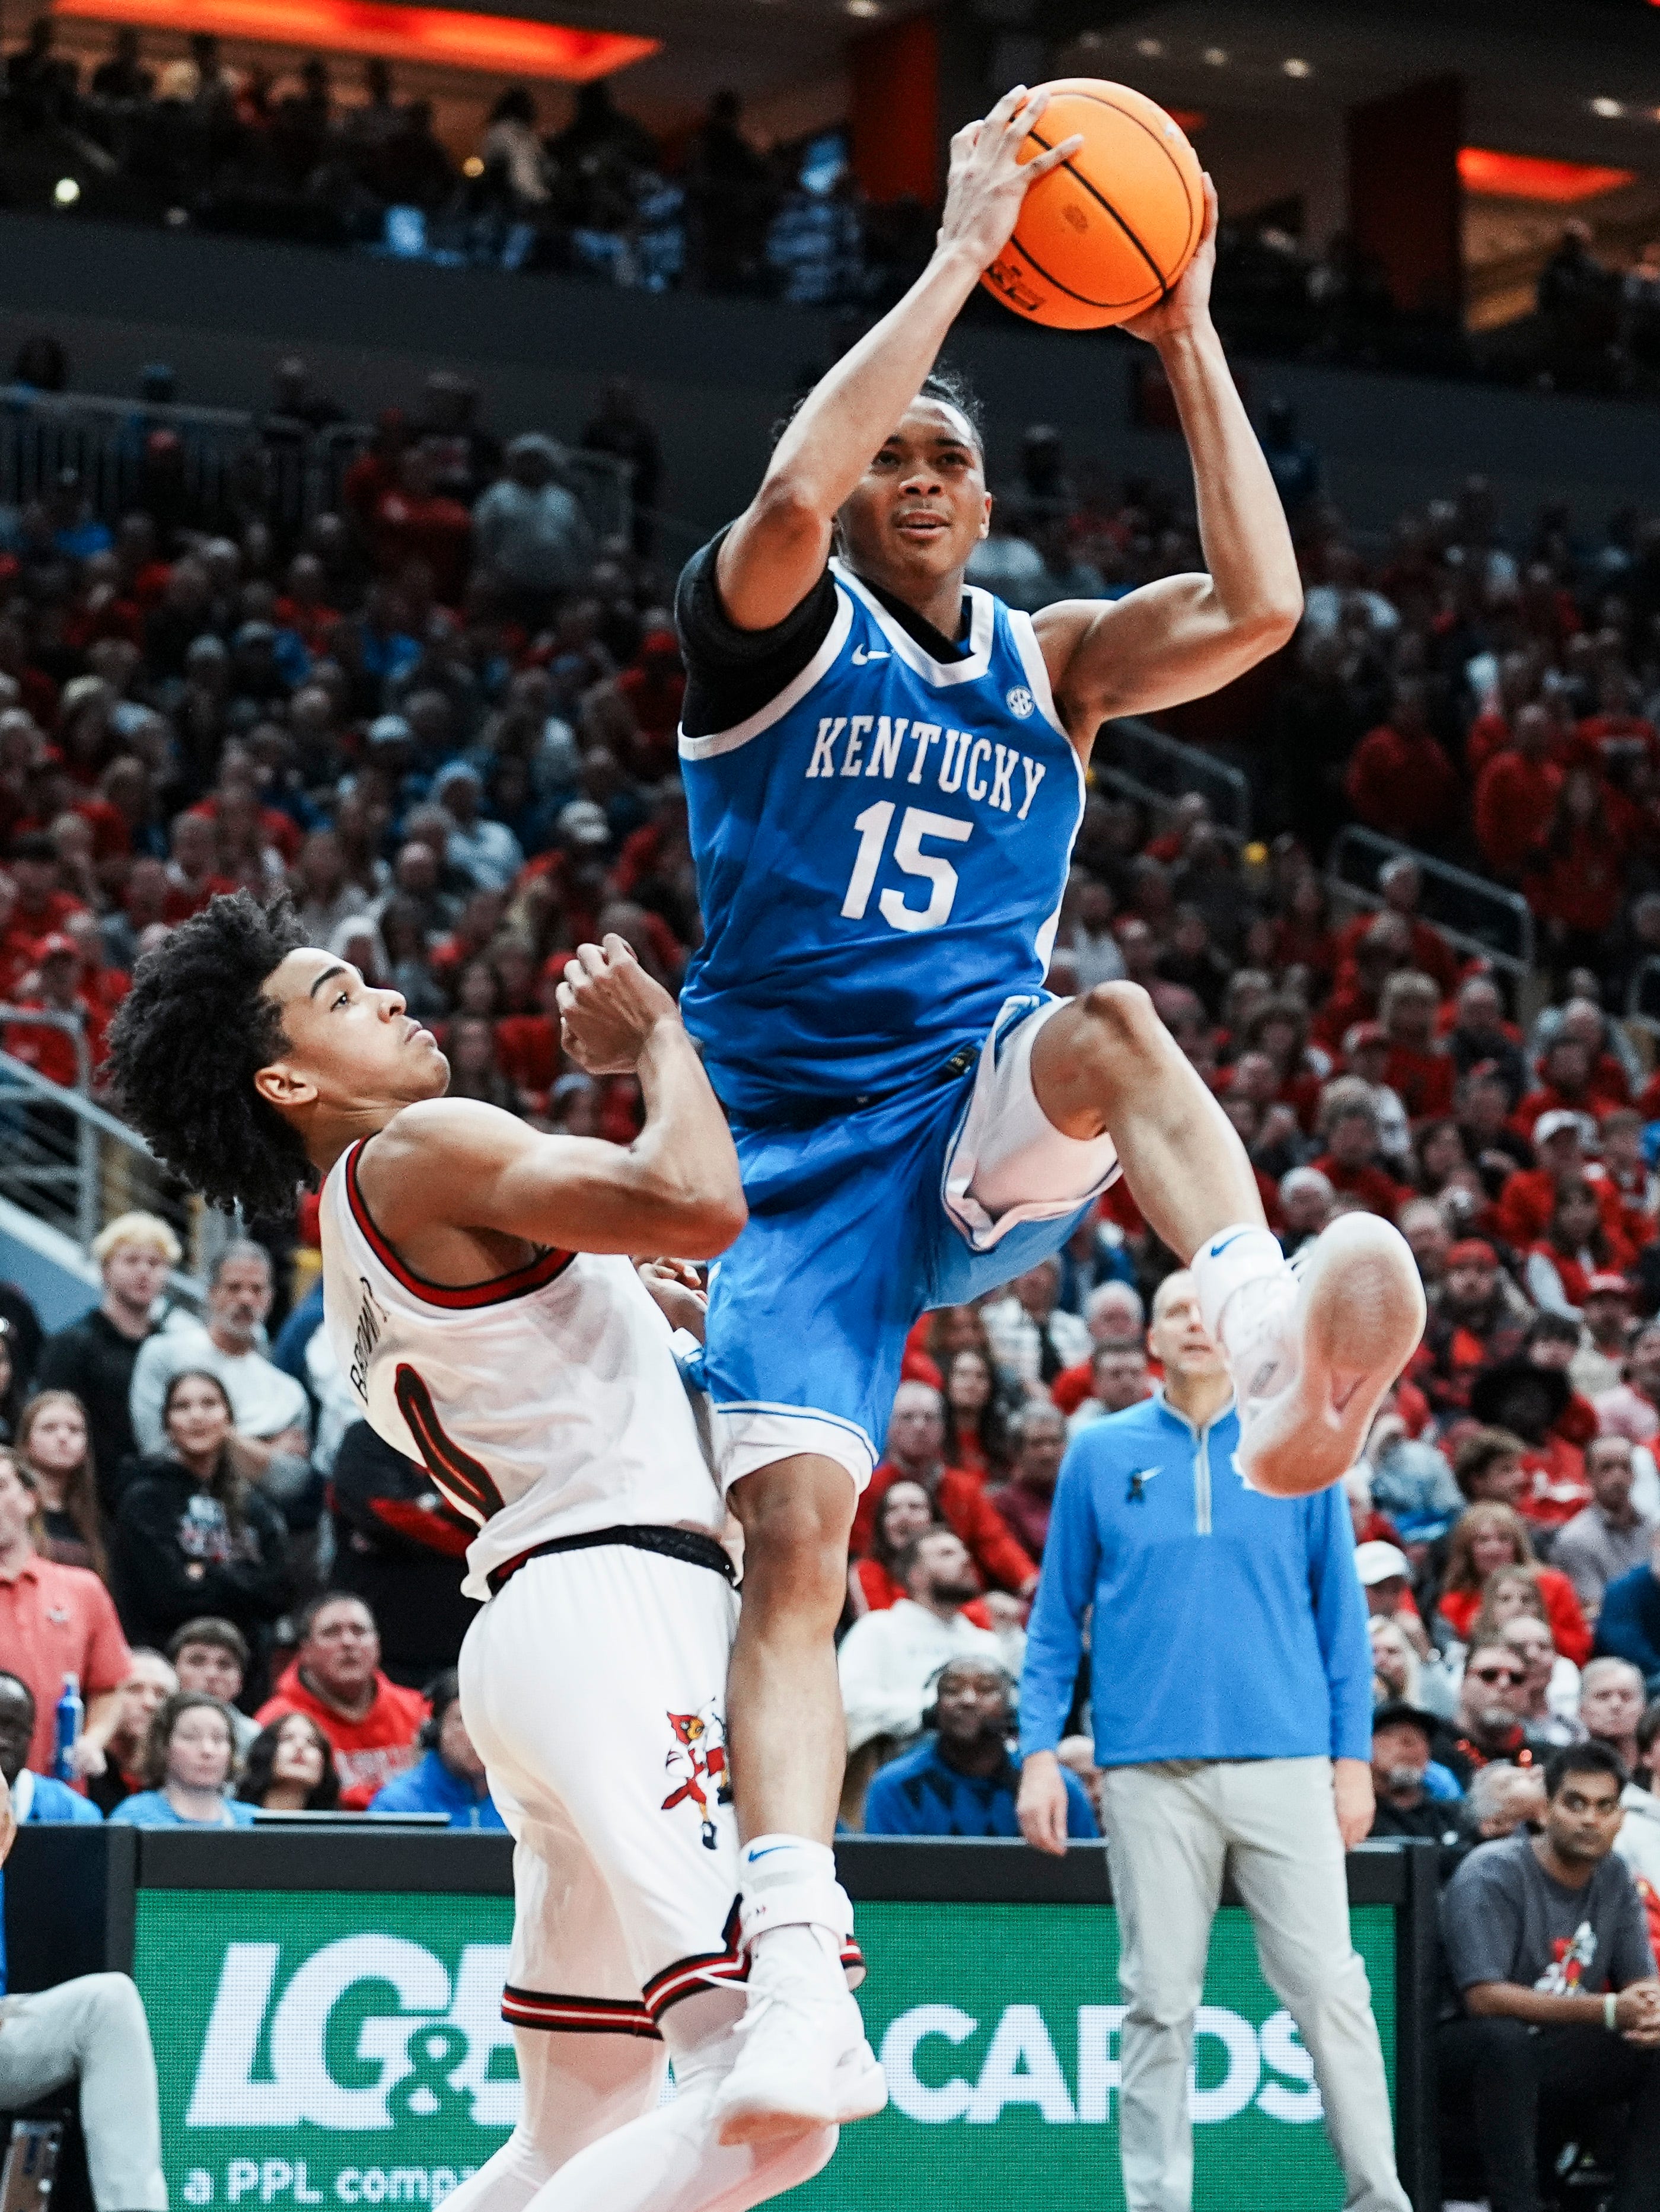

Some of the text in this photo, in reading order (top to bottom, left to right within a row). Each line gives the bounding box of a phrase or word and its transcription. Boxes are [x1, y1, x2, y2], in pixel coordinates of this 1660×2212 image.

[805, 715, 1046, 821] KENTUCKY
[840, 800, 974, 933] 15
[394, 1363, 505, 1522] 0
[184, 2157, 477, 2211] a PPL comp
